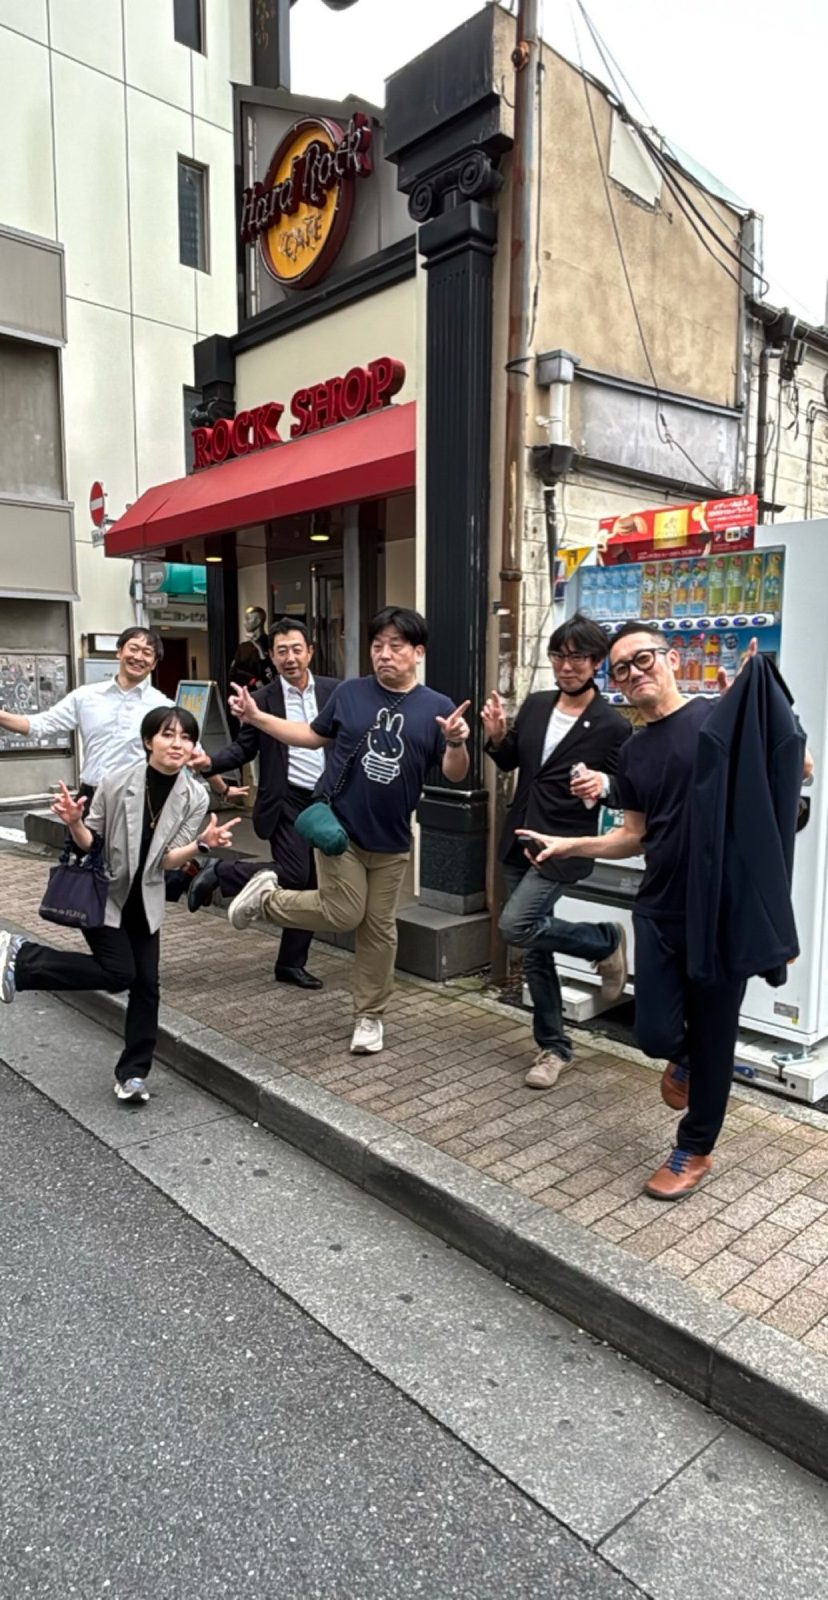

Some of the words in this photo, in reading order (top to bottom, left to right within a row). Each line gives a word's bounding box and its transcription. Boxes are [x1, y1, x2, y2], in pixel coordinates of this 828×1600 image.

[240, 156, 300, 240] Hard
[300, 112, 373, 208] Rock
[191, 401, 284, 470] ROCK
[289, 356, 406, 440] SHOP
